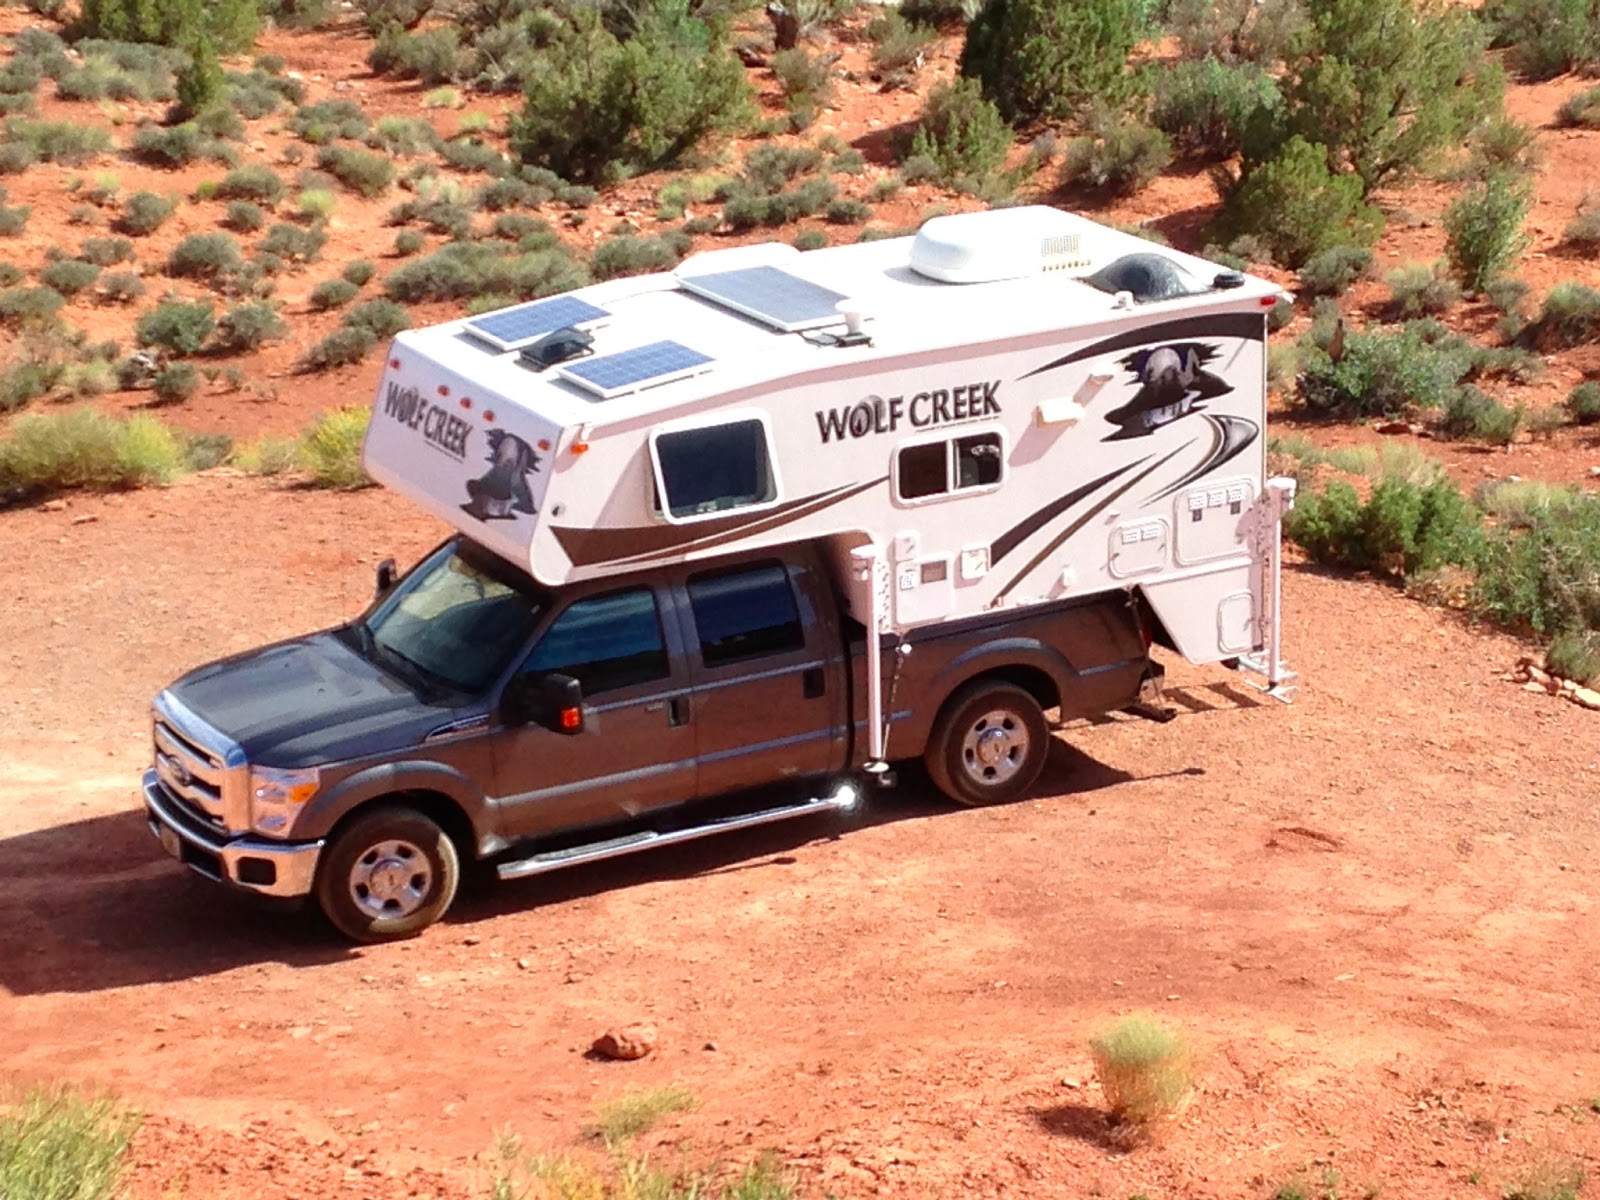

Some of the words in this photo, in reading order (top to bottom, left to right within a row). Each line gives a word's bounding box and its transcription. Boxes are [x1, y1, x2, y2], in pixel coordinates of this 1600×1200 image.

[385, 381, 428, 430] WOLF
[424, 405, 474, 458] CREEK
[815, 395, 904, 443] WOLF
[909, 379, 1002, 427] CREEK
